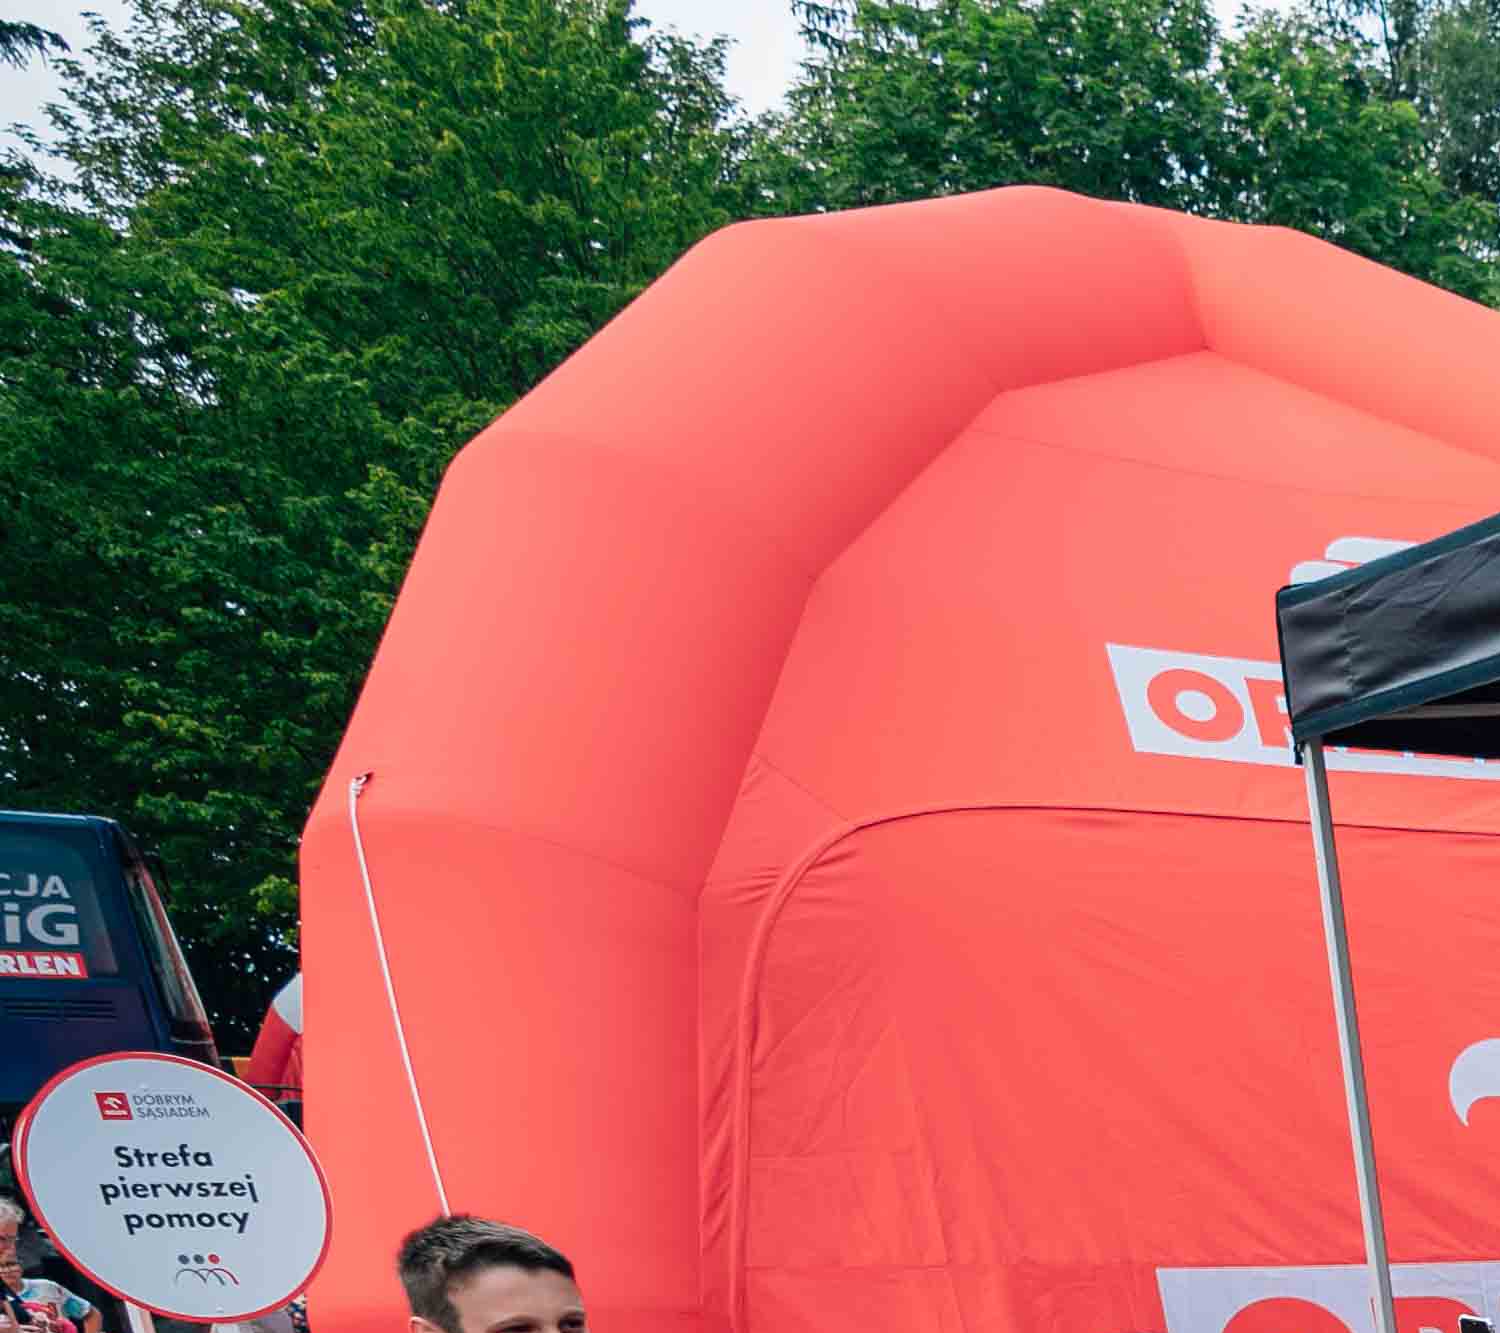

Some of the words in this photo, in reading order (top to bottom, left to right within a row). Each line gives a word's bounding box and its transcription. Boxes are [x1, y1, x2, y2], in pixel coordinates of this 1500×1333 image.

[0, 954, 81, 976] RLEN
[114, 1143, 214, 1168] Strefa
[99, 1173, 260, 1206] pierwszej
[123, 1211, 249, 1235] pomocy
